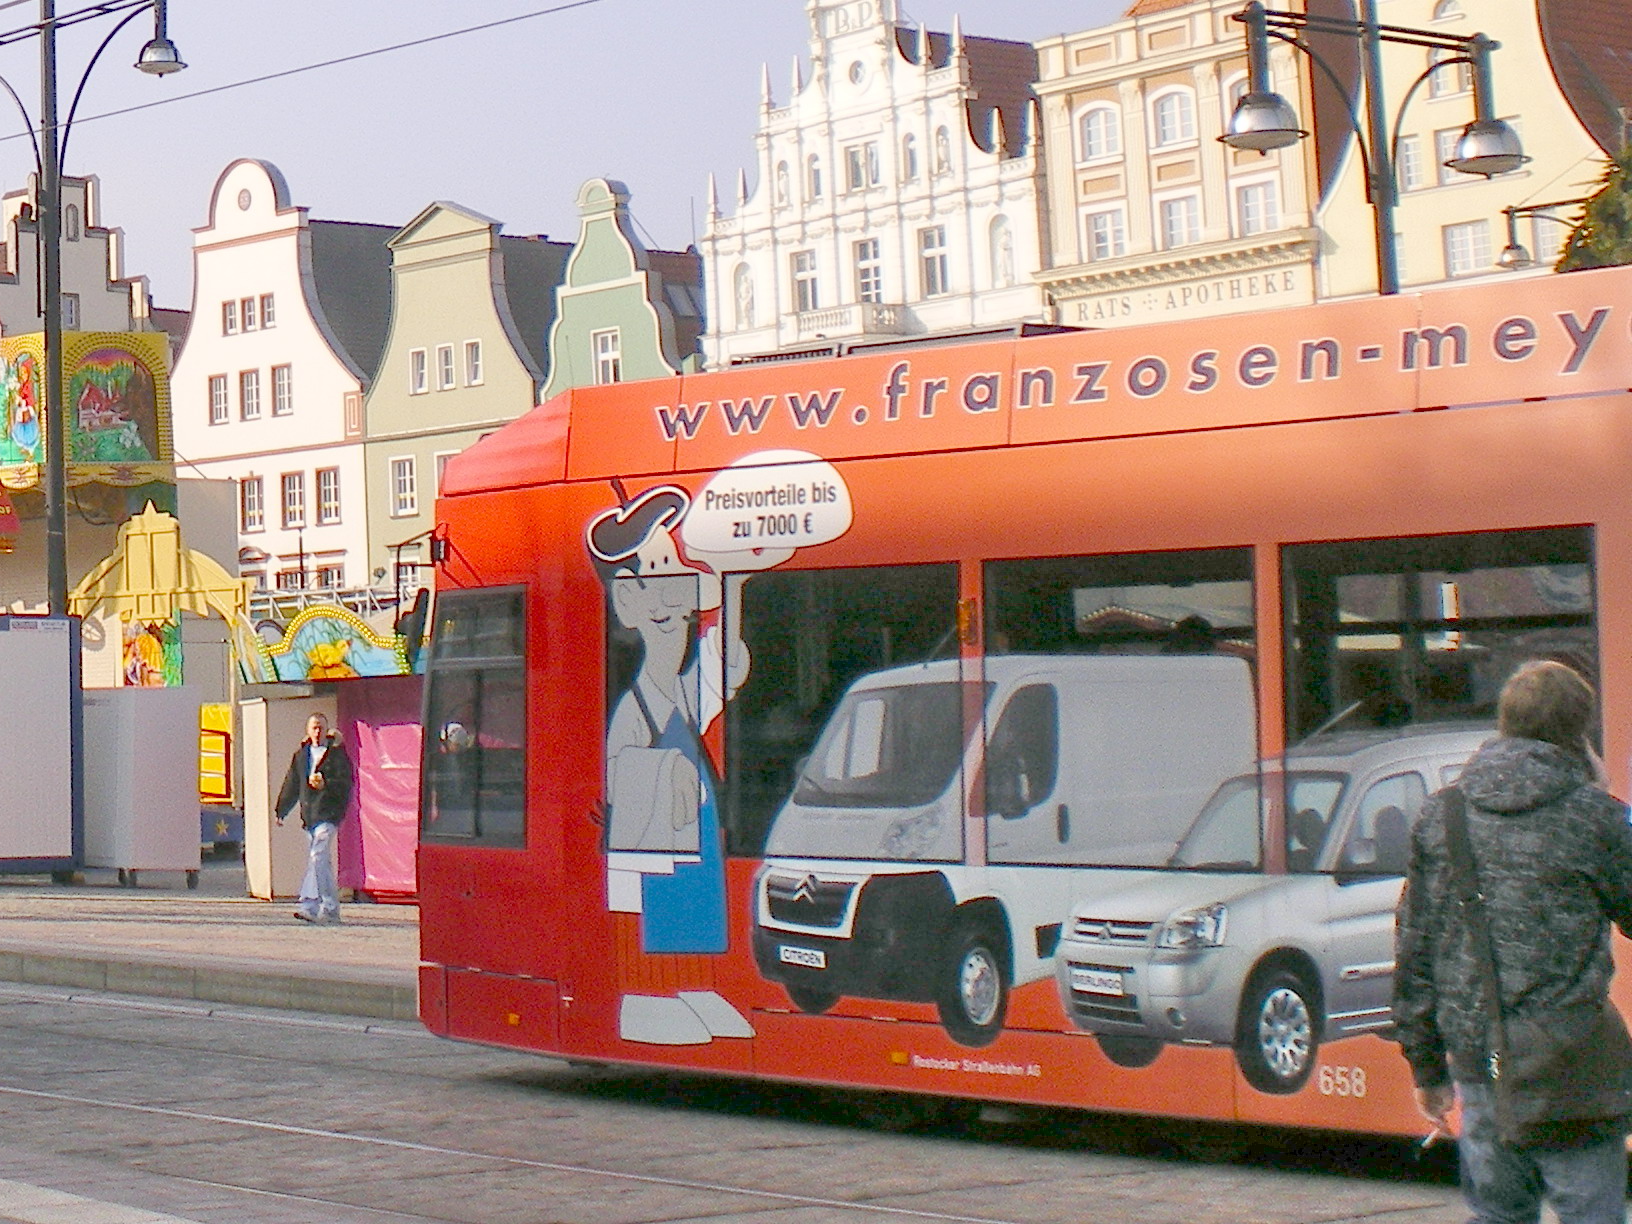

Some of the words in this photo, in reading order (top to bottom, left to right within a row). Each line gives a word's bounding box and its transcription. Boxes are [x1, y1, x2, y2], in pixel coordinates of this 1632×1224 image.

[1077, 296, 1132, 322] RATS
[1165, 270, 1296, 310] APOTHEKE
[655, 306, 1632, 442] www.franzosen-mey
[705, 483, 806, 511] Preisvorteile
[812, 481, 837, 504] bis
[732, 520, 751, 538] zu
[757, 513, 798, 537] 7000
[803, 512, 814, 534] €
[1319, 1064, 1366, 1098] 658
